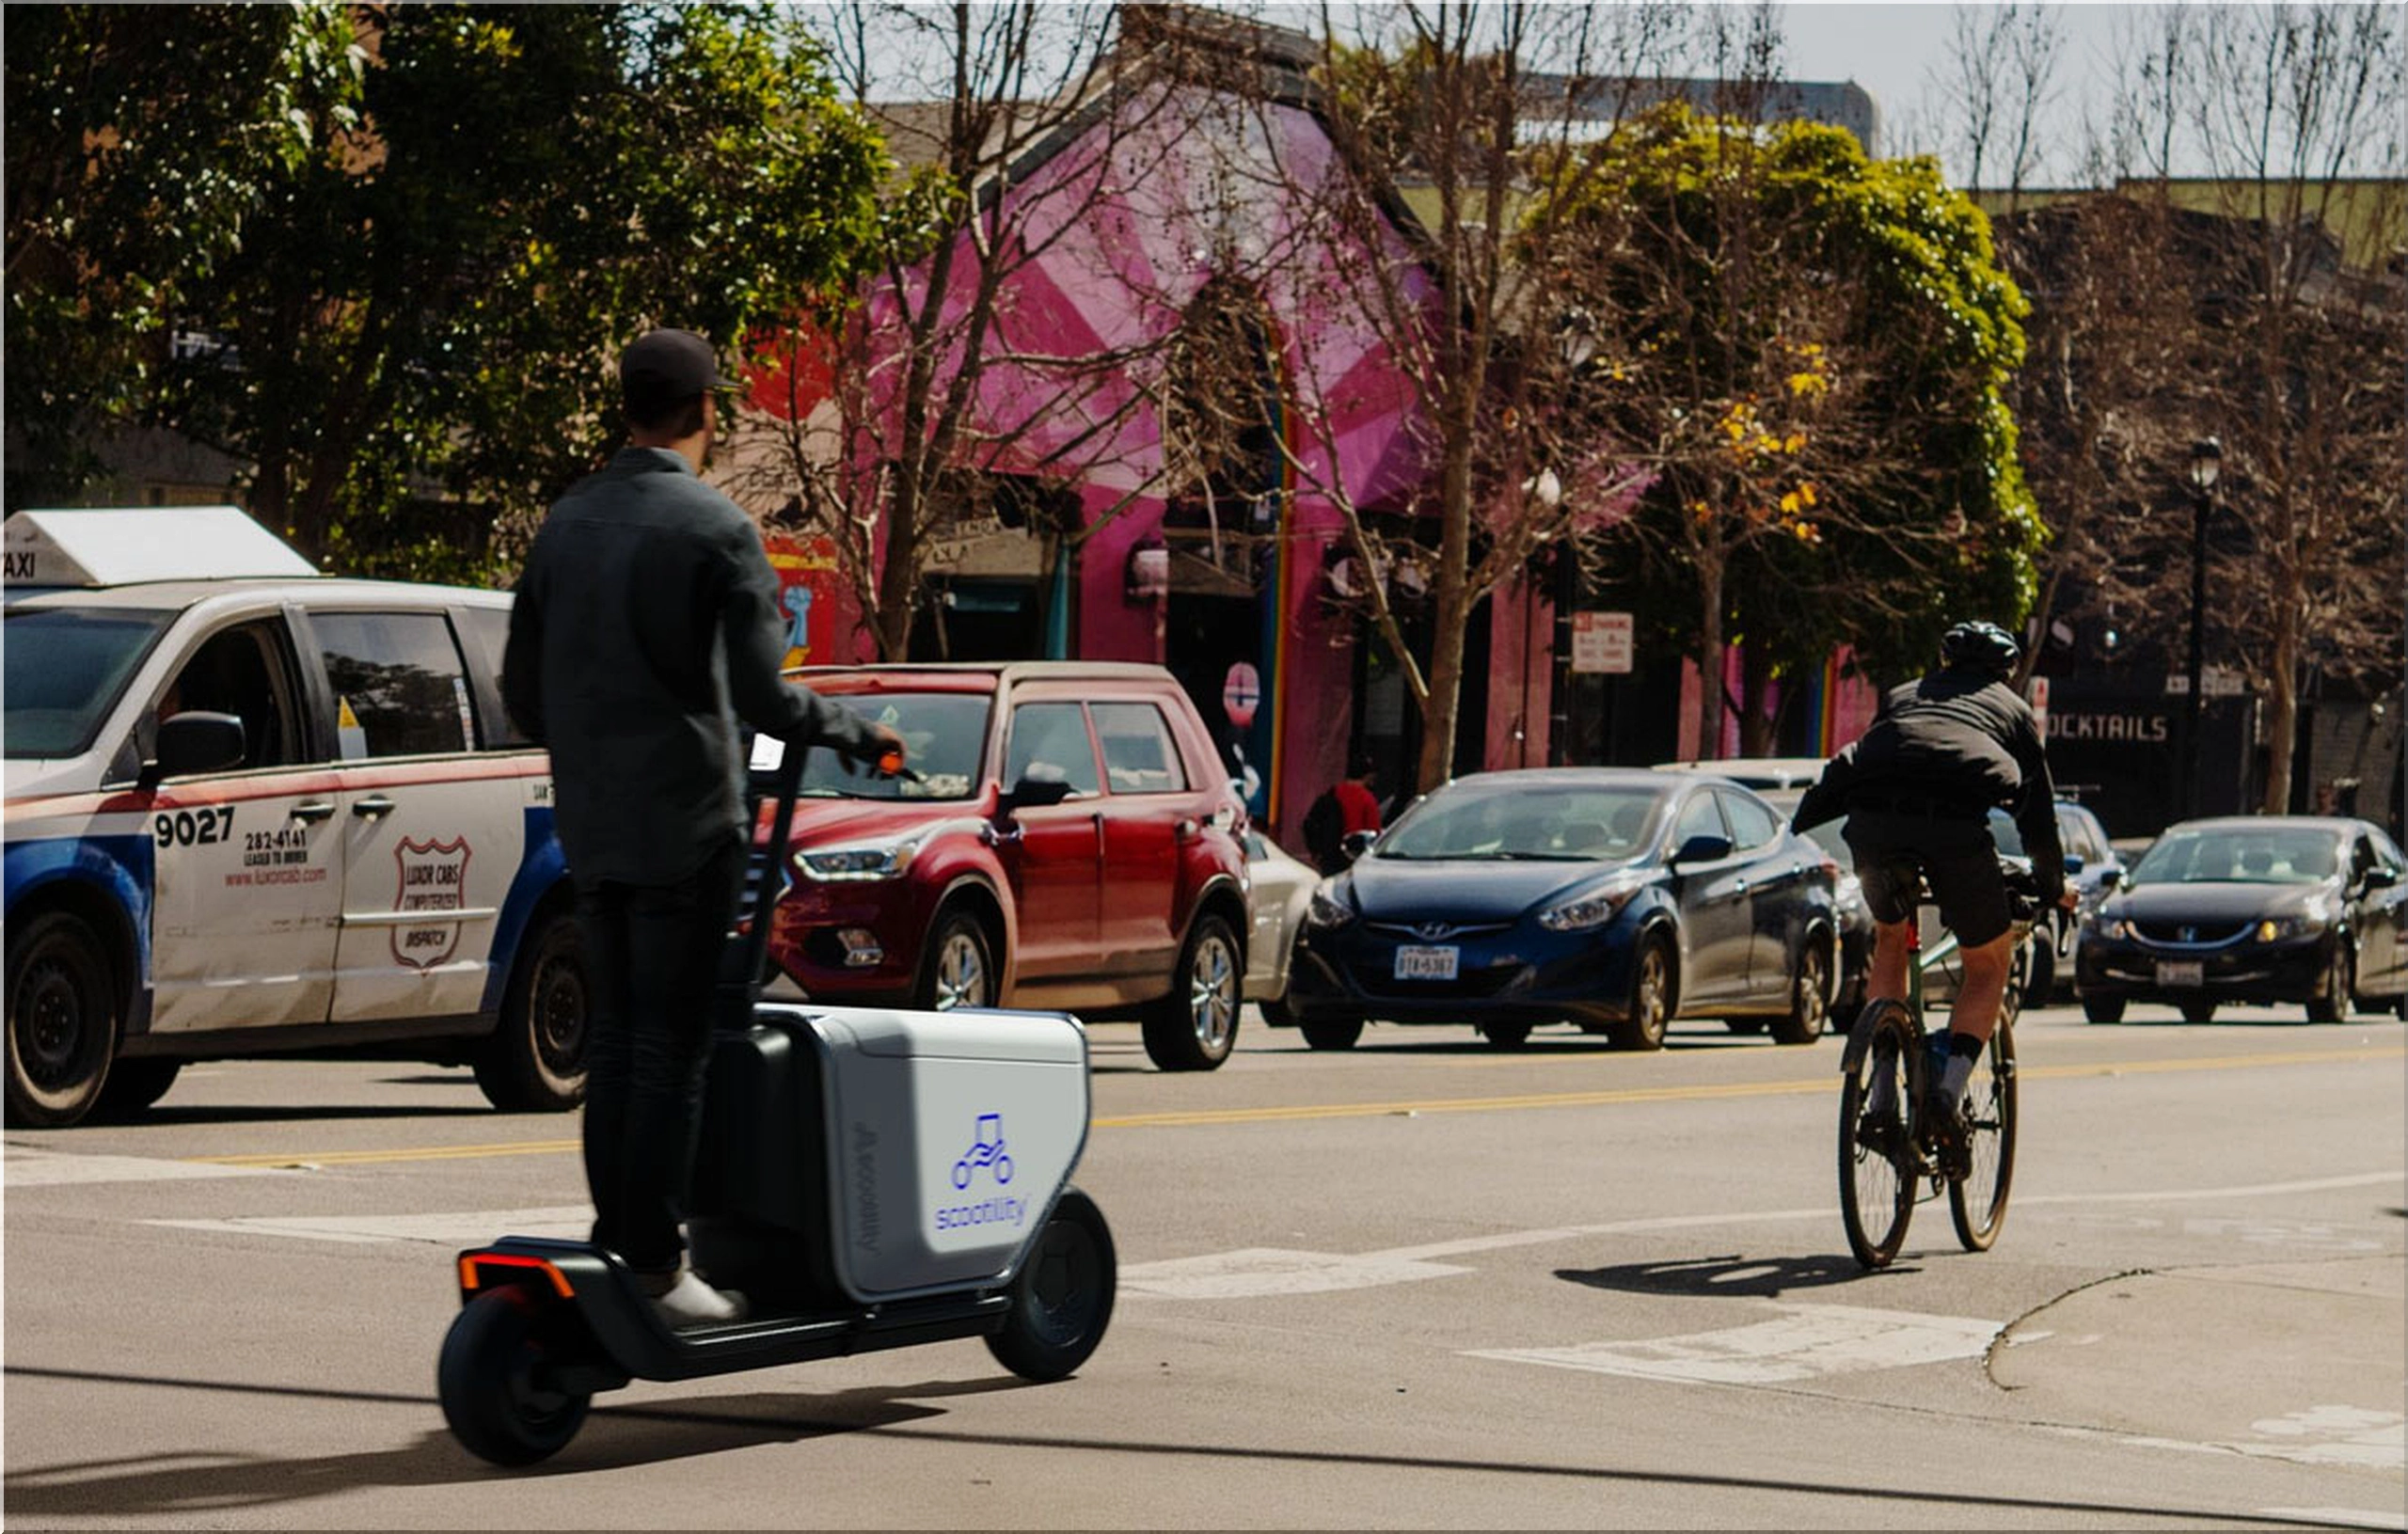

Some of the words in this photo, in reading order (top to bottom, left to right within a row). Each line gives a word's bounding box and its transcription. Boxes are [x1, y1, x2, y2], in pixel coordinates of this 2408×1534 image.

[4, 552, 36, 578] AXI
[2046, 713, 2166, 741] OCKTAILS
[155, 806, 235, 847] 9027
[246, 830, 307, 851] 282-4141
[436, 864, 459, 884] CABS
[936, 1197, 1026, 1229] scootility
